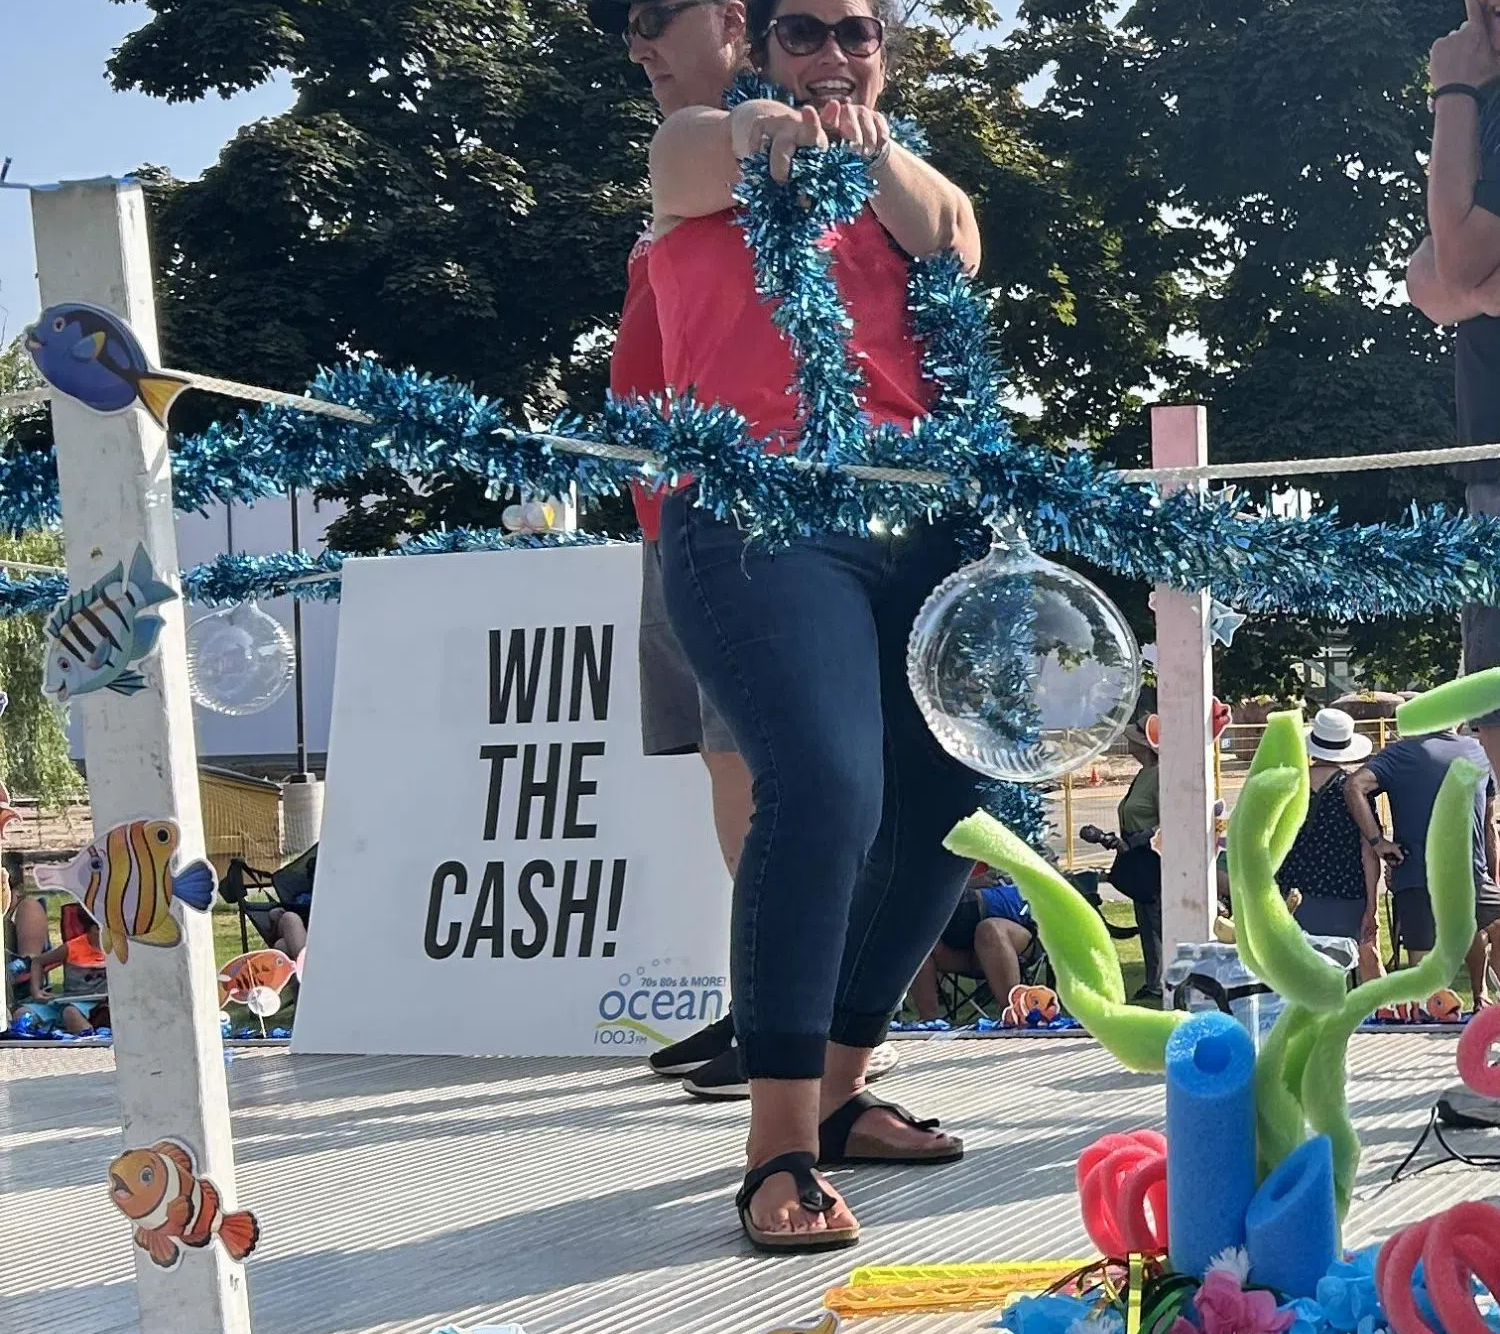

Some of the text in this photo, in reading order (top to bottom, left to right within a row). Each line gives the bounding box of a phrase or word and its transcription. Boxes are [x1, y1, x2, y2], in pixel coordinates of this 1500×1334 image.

[488, 624, 615, 725] WIN
[479, 741, 606, 841] THE
[423, 858, 627, 959] CASH!
[599, 989, 723, 1020] ocean
[680, 976, 688, 987] &
